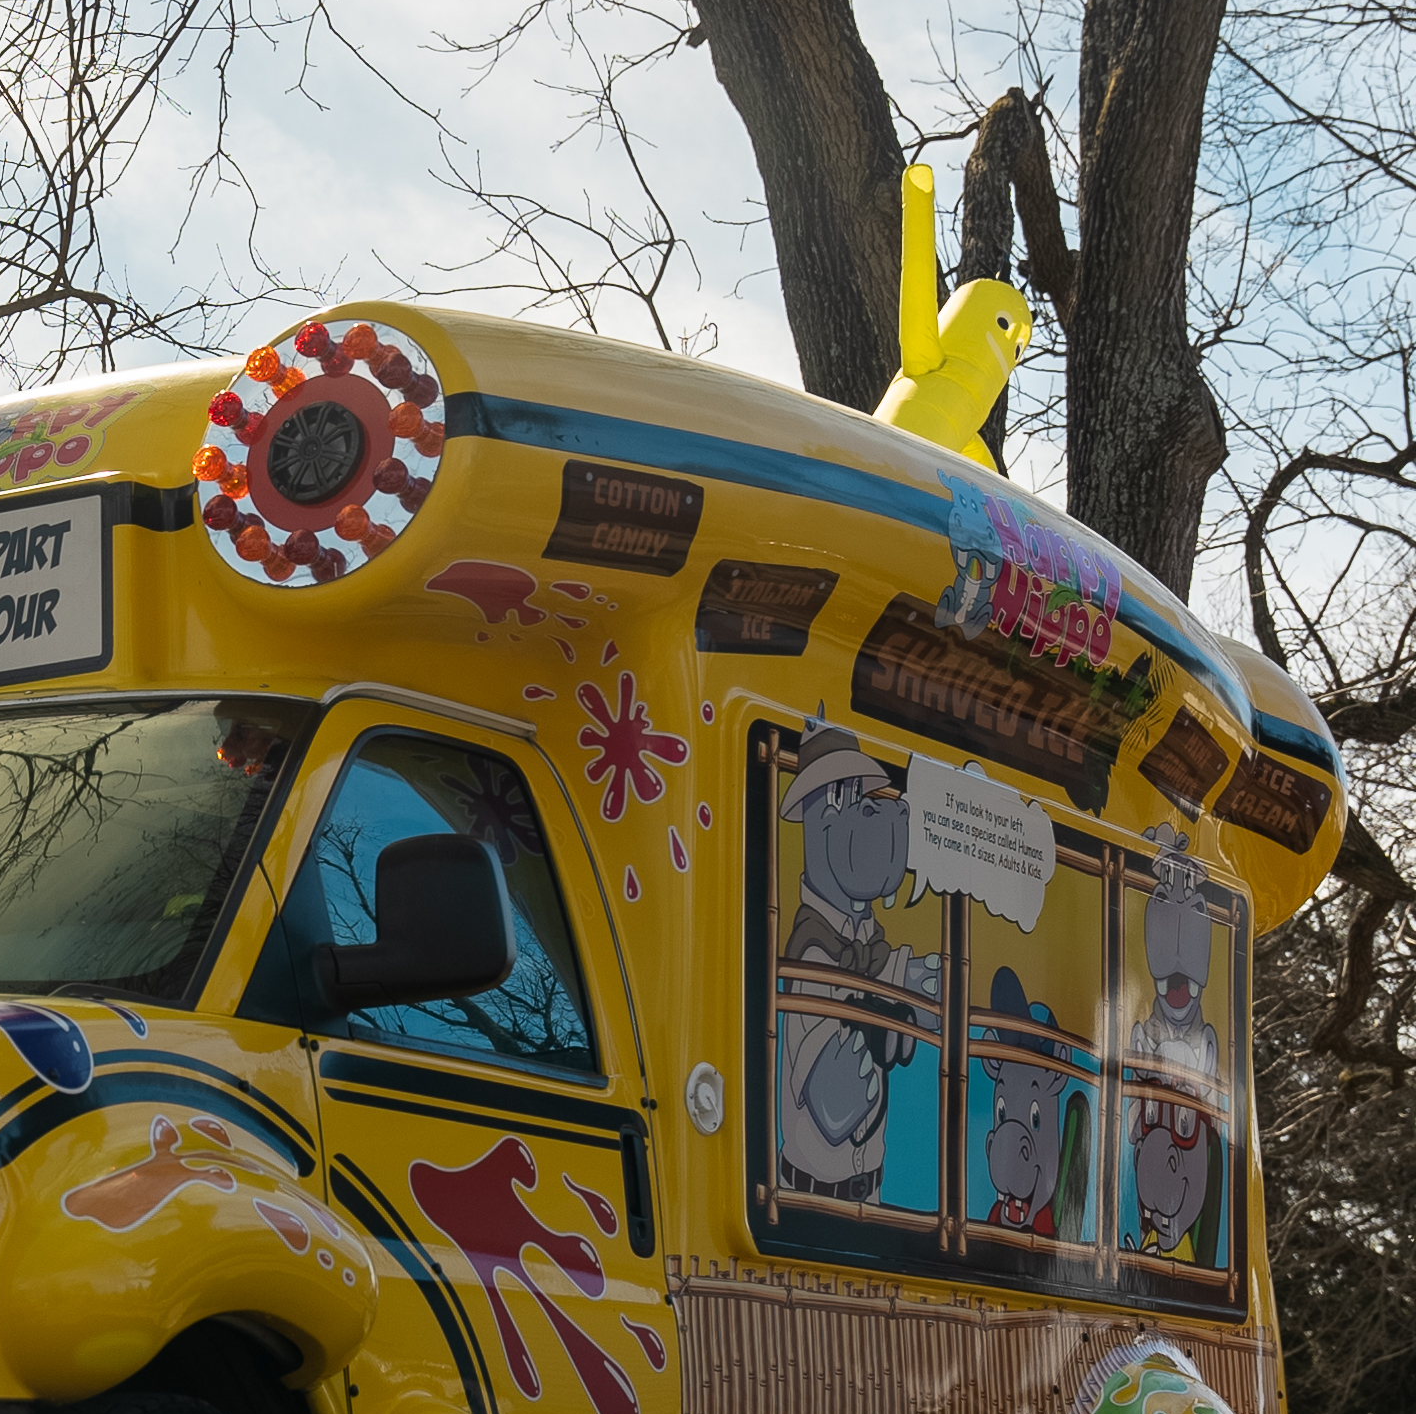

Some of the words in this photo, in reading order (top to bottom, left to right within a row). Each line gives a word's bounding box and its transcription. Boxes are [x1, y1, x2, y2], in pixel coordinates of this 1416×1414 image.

[594, 477, 681, 517] COTTON
[591, 522, 669, 557] CANDY
[984, 493, 1122, 622] Happy
[725, 578, 816, 606] ITALIAN
[990, 560, 1113, 667] Hippo
[741, 615, 774, 640] ICE
[871, 632, 1034, 737] SHAVED
[1027, 690, 1104, 765] ICE
[1257, 762, 1296, 797] ICE
[923, 809, 936, 825] you
[937, 814, 951, 829] can
[951, 818, 964, 833] see
[964, 824, 970, 835] a
[971, 826, 996, 845] species
[997, 833, 1017, 852] called
[945, 792, 955, 809] If
[955, 799, 968, 814] you
[969, 800, 984, 819] look
[985, 808, 993, 822] to
[993, 813, 1009, 828] your
[1010, 815, 1025, 836] left,
[1230, 790, 1299, 834] CREAM
[923, 826, 942, 850] They
[943, 837, 962, 853] come
[963, 840, 971, 856] in
[971, 843, 977, 858] 2
[977, 846, 997, 867] sizes,
[998, 853, 1020, 873] Adults
[1021, 859, 1026, 875] &
[1027, 862, 1043, 881] Kids.
